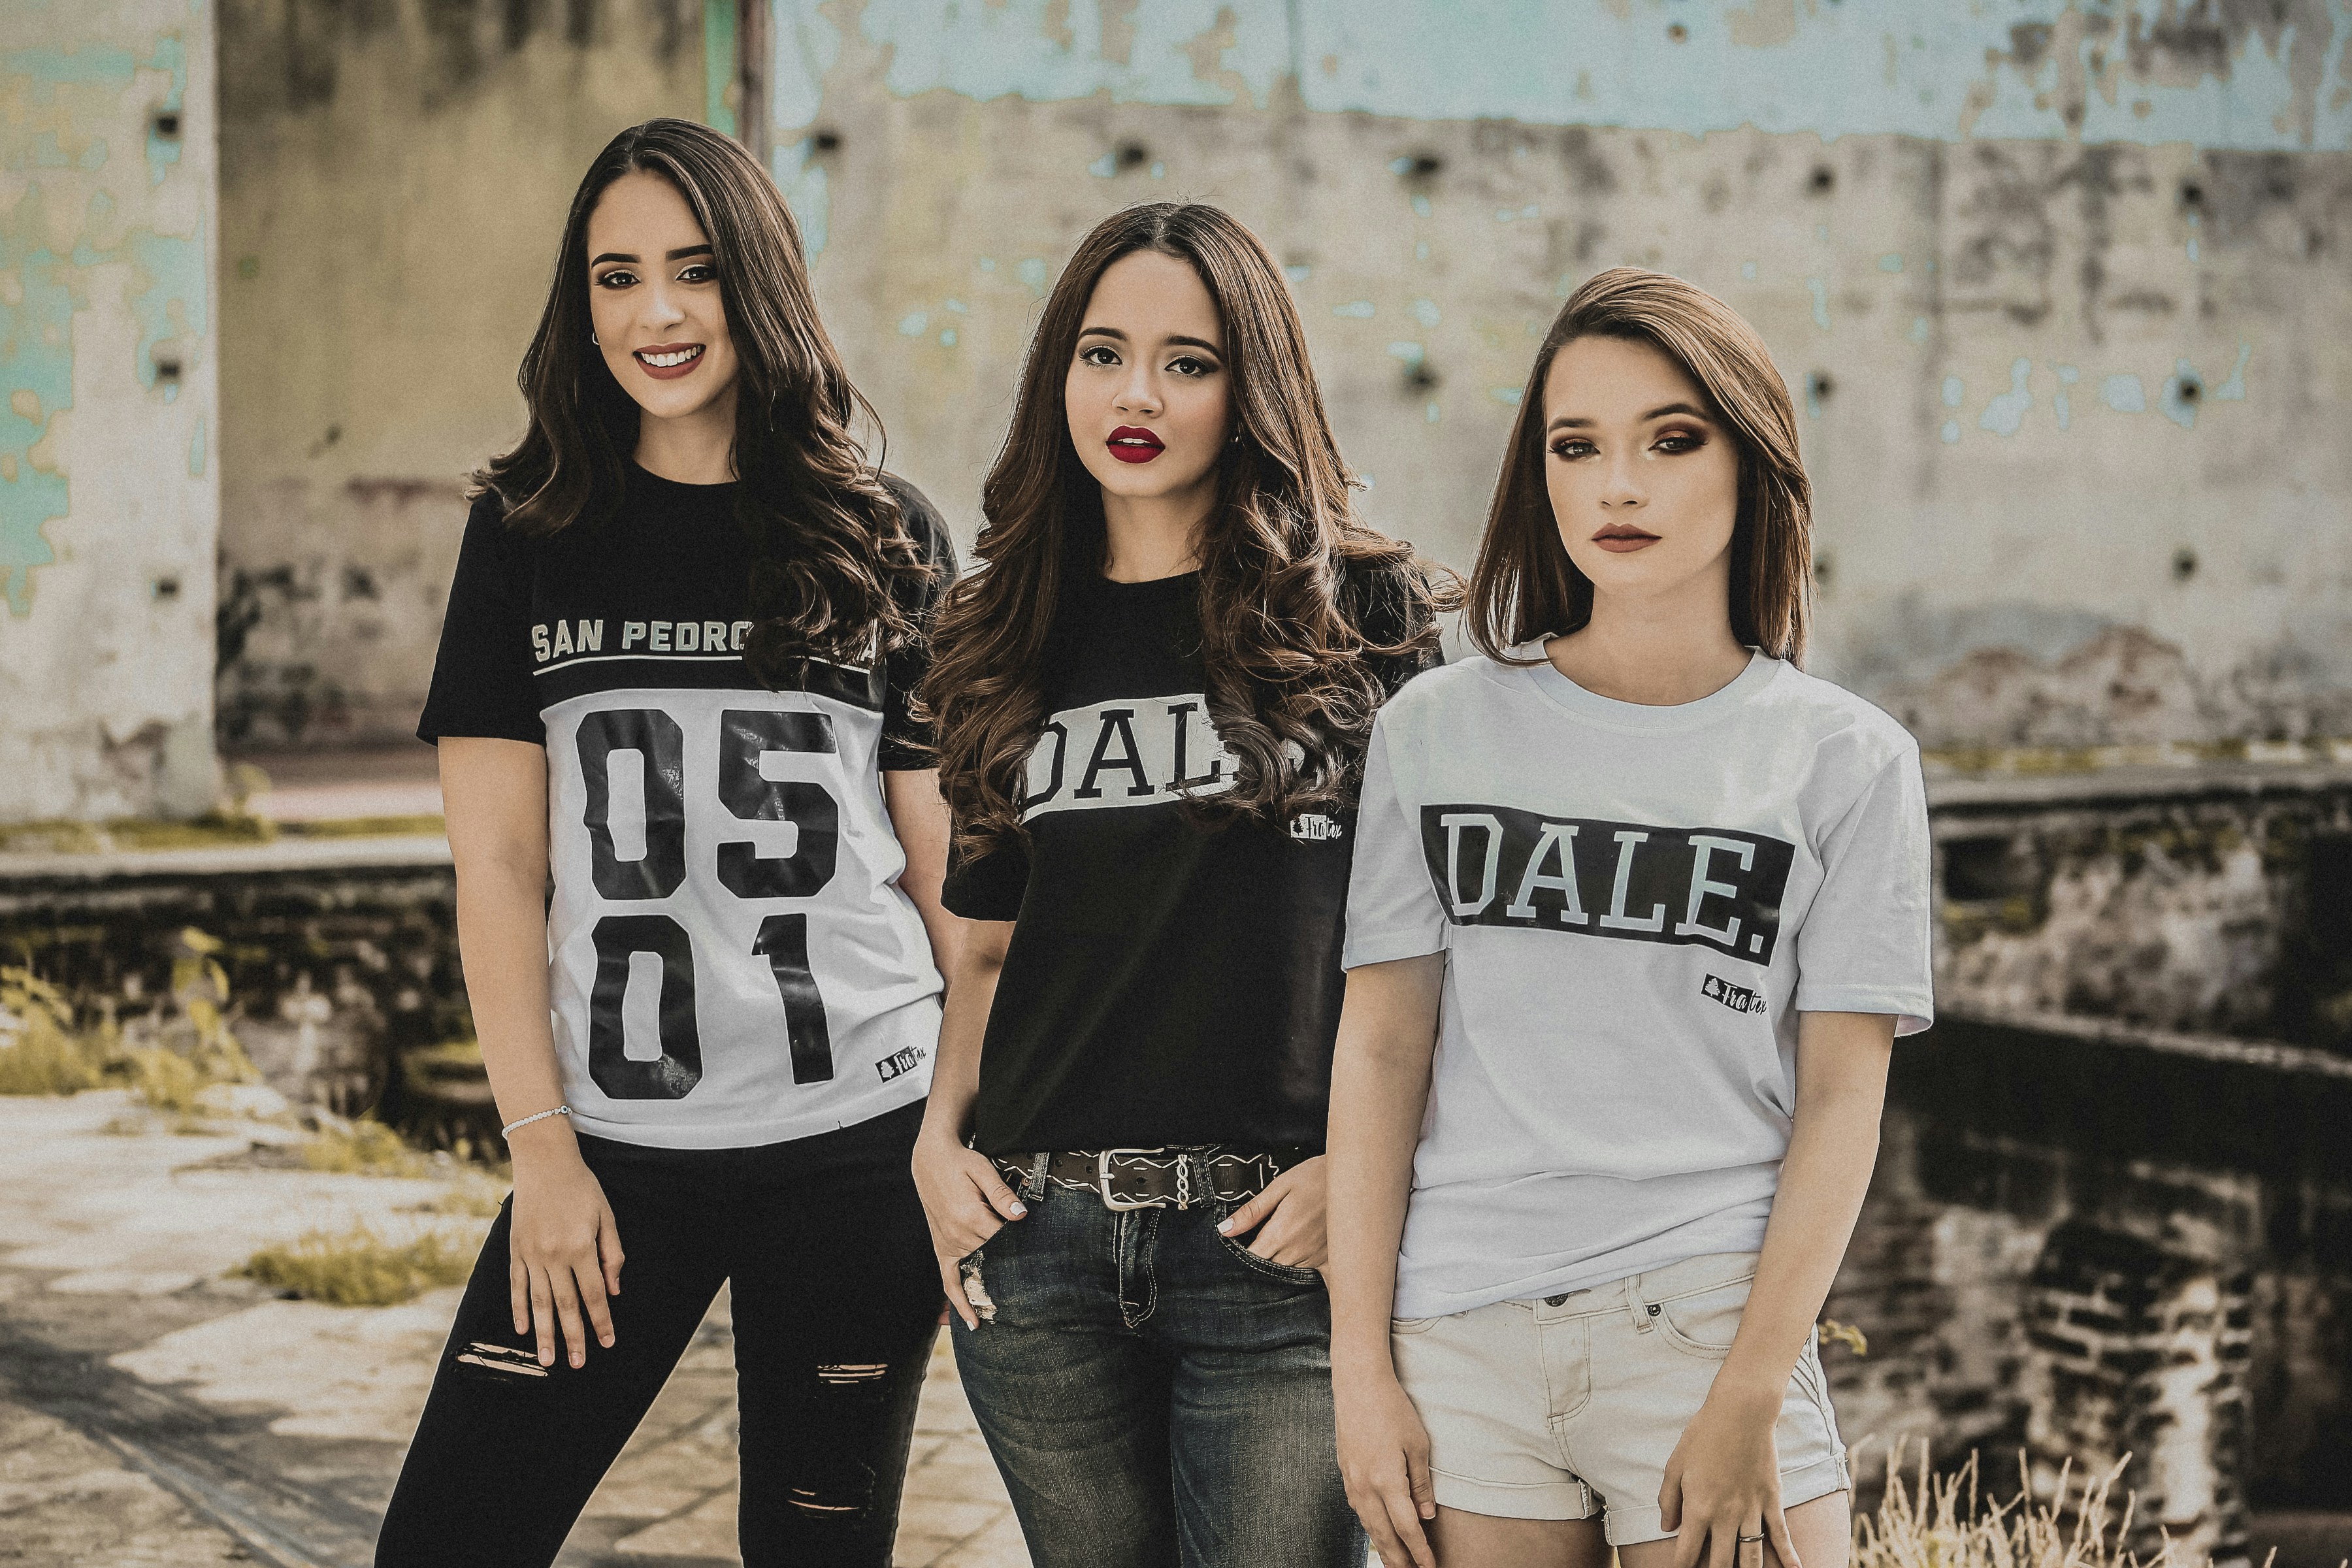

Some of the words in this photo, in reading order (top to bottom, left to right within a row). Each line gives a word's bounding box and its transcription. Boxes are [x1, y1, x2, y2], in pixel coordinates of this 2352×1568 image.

[531, 619, 604, 662] SAN
[575, 709, 839, 900] 05
[1440, 813, 1764, 954] DALE.
[588, 913, 836, 1100] 01
